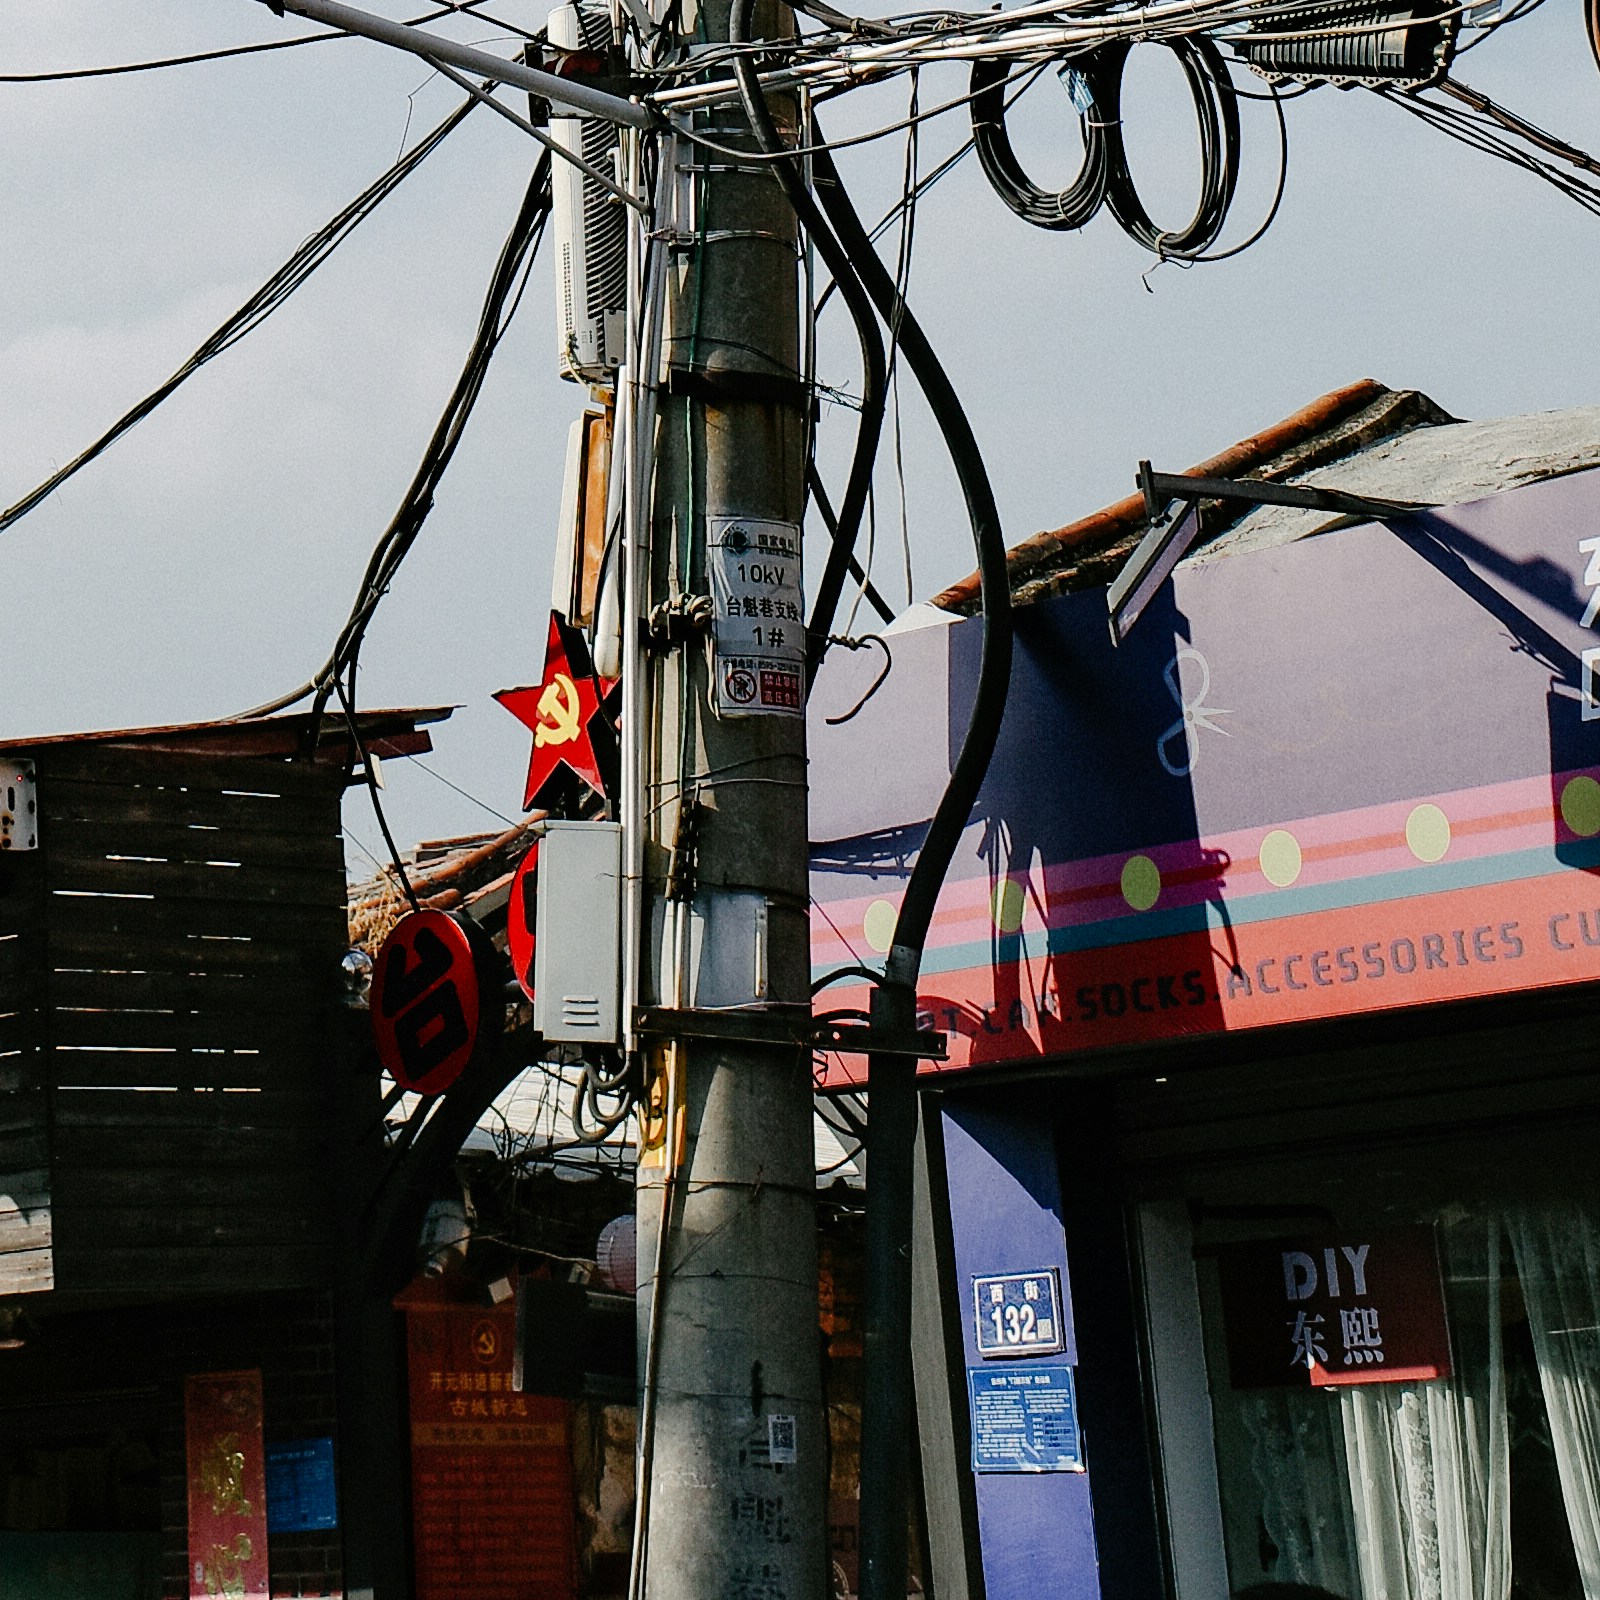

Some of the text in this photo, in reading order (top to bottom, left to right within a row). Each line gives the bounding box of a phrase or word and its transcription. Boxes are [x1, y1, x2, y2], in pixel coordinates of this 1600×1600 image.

[738, 563, 785, 586] 10kV
[727, 595, 799, 622] 台魁巷支线
[752, 626, 785, 648] 1#
[1281, 1244, 1370, 1300] DIY
[990, 1280, 1040, 1303] 西街
[991, 1303, 1037, 1344] 132
[1286, 1306, 1385, 1370] 东熙
